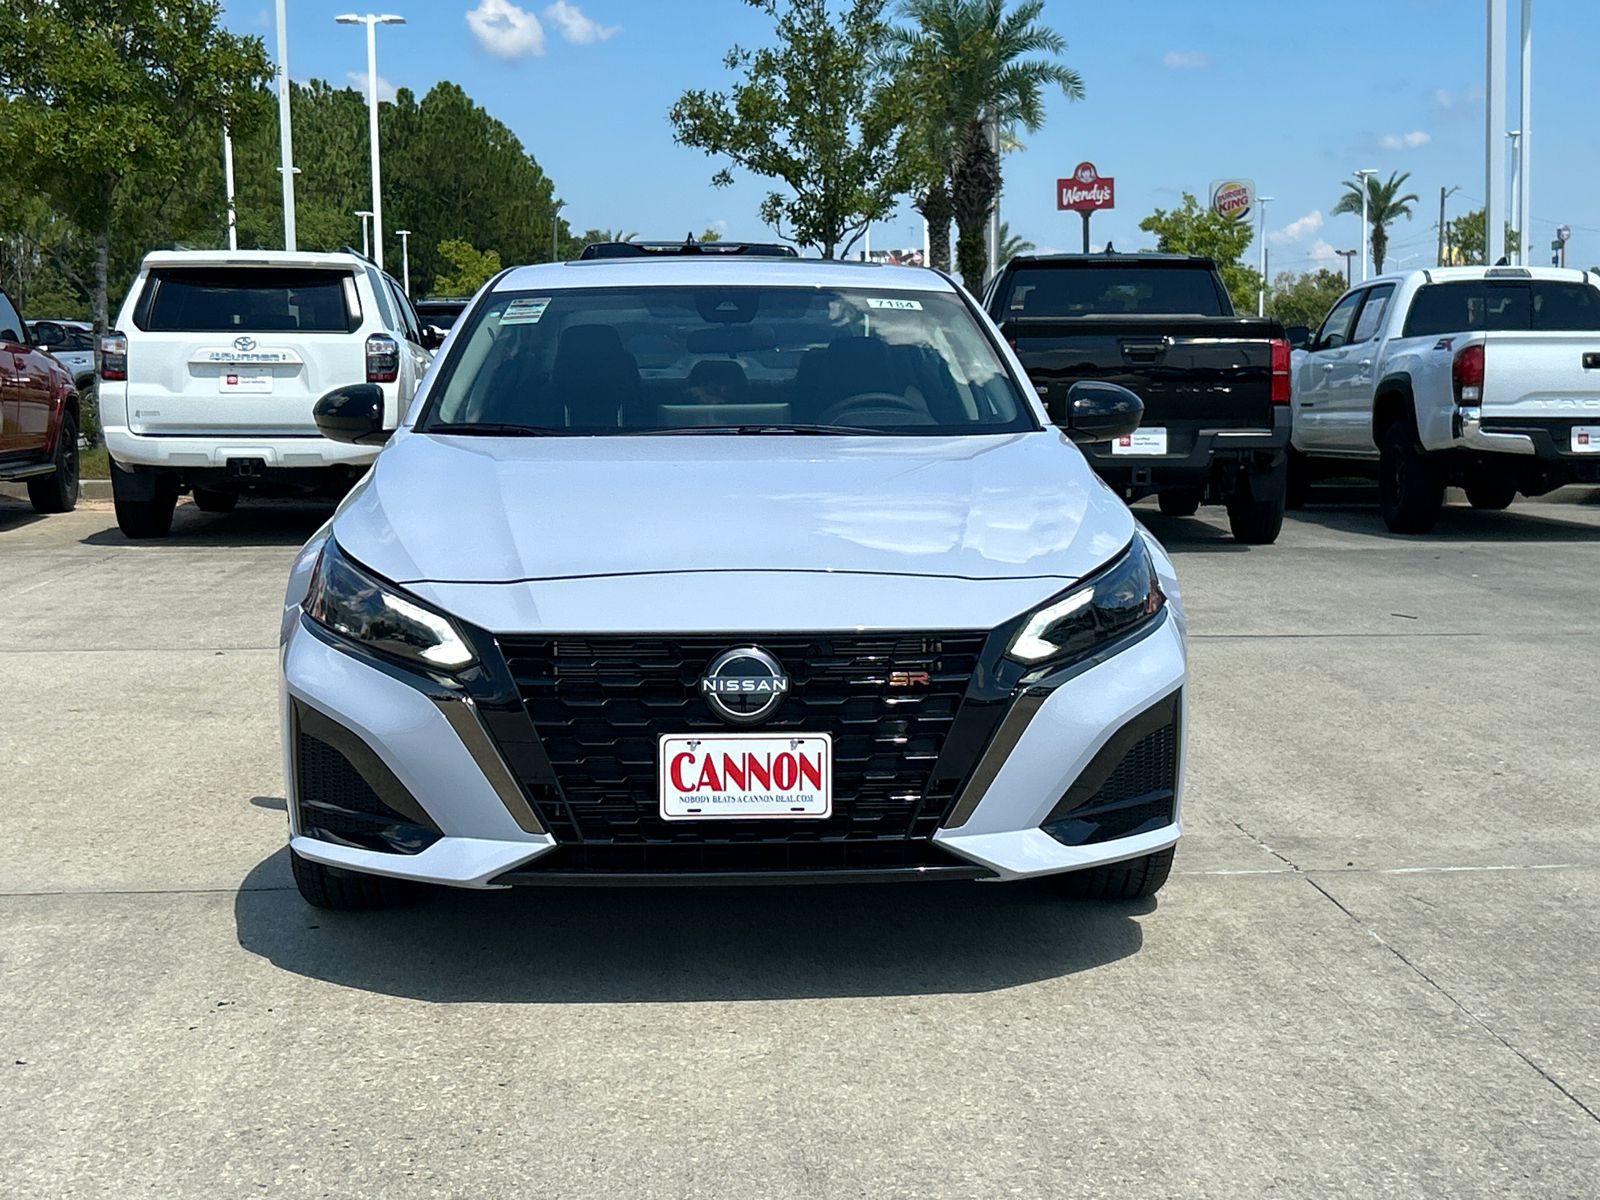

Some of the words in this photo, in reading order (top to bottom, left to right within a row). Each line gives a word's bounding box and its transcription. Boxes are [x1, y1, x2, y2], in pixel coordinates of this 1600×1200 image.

[1062, 183, 1111, 206] Wendy's
[1217, 187, 1247, 203] BURGER
[1218, 195, 1249, 212] KING
[703, 679, 787, 692] NISSAN
[889, 671, 930, 687] SR
[670, 751, 822, 792] CANNON
[679, 795, 710, 803] NOBODY
[712, 795, 736, 803] BEATS
[743, 795, 774, 803] CANNON
